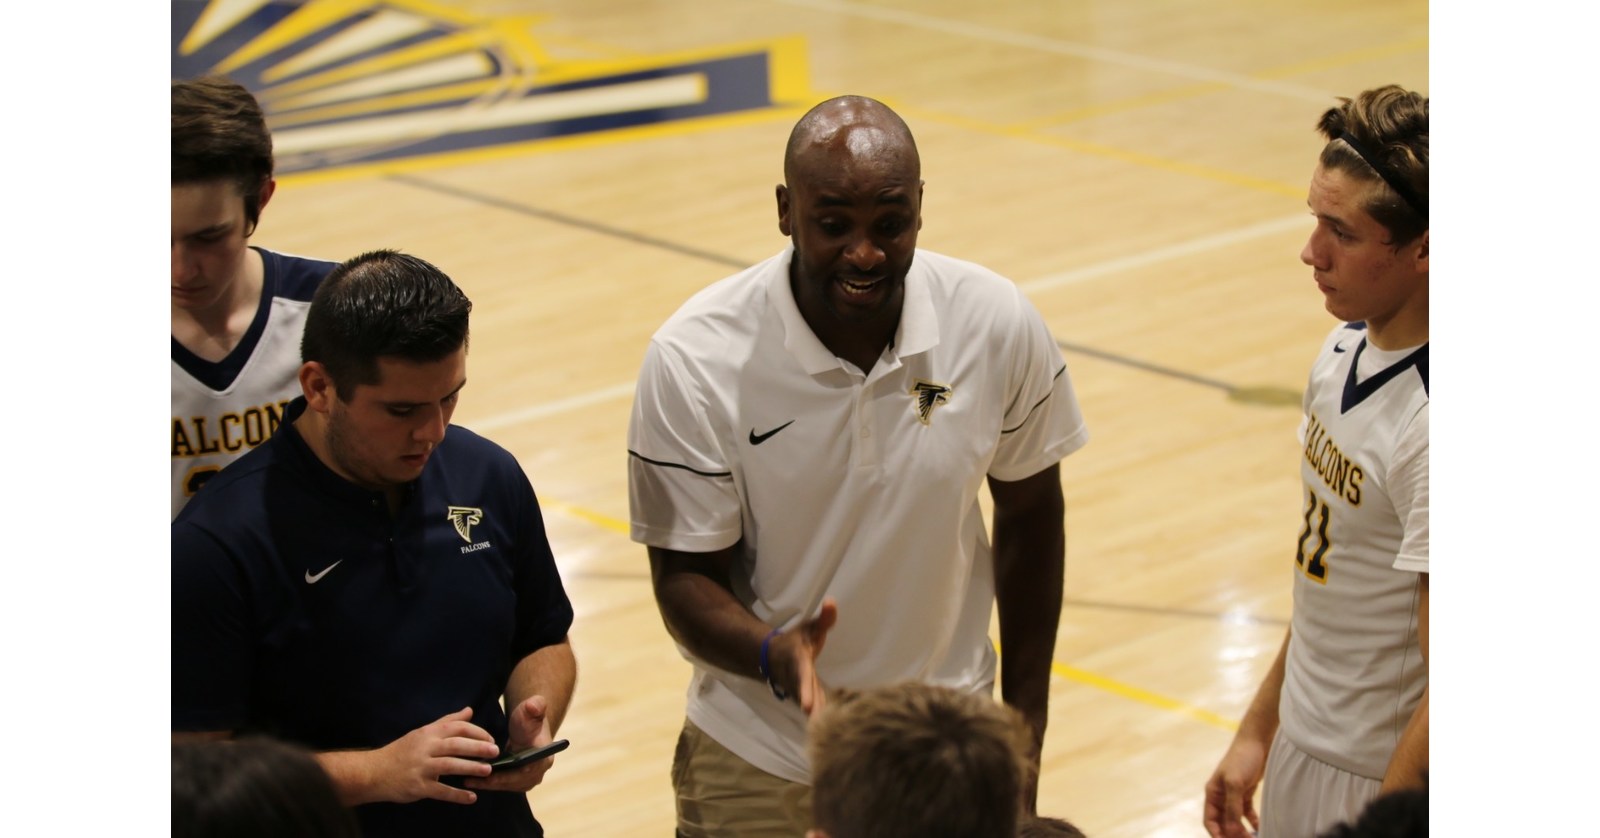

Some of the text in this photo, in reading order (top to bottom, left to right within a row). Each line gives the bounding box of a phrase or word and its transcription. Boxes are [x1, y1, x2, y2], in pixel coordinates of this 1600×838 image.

[1304, 412, 1364, 508] FALCONS
[460, 541, 491, 554] FALCONS
[1296, 486, 1329, 586] 11
